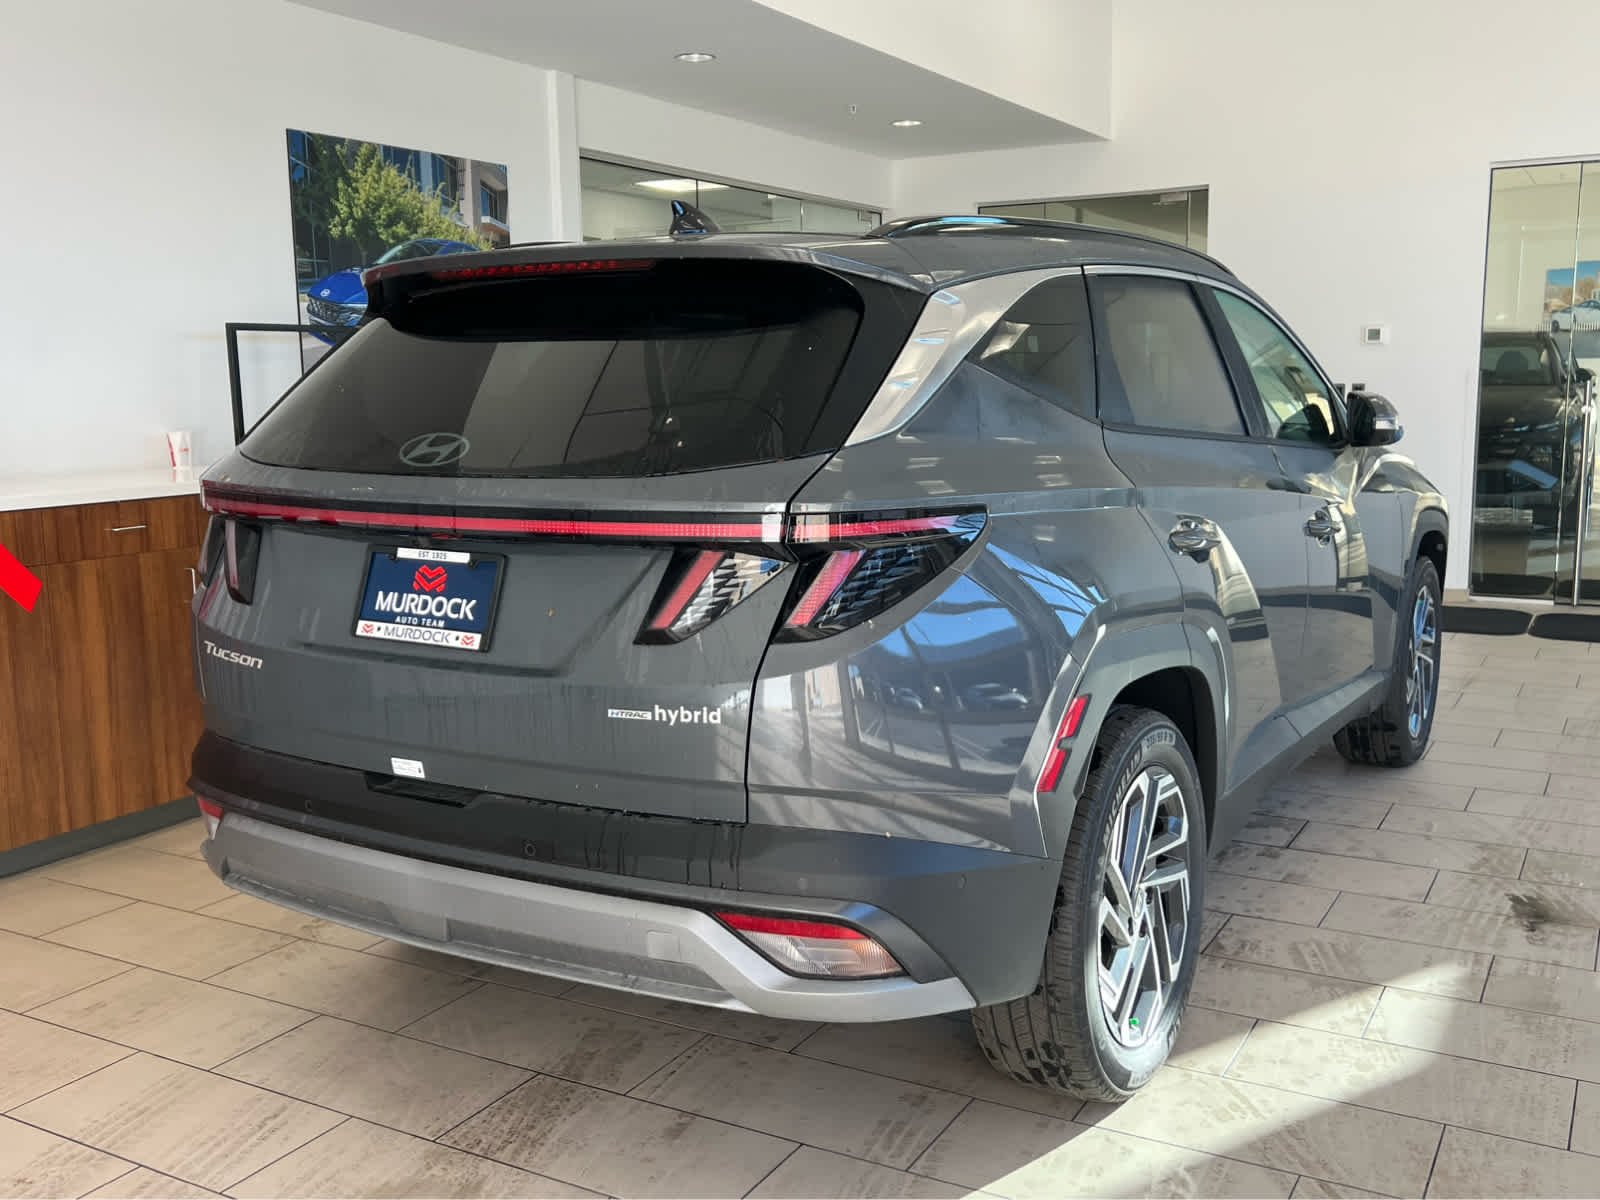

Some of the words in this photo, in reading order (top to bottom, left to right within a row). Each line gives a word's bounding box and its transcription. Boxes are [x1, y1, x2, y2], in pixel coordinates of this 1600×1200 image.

[418, 550, 430, 559] EST
[375, 590, 477, 621] MURDOCK
[395, 615, 418, 625] AUTO
[421, 617, 445, 628] TEAM
[383, 625, 450, 644] MURDOCK
[203, 640, 263, 669] Tucson
[654, 704, 721, 726] hybrid
